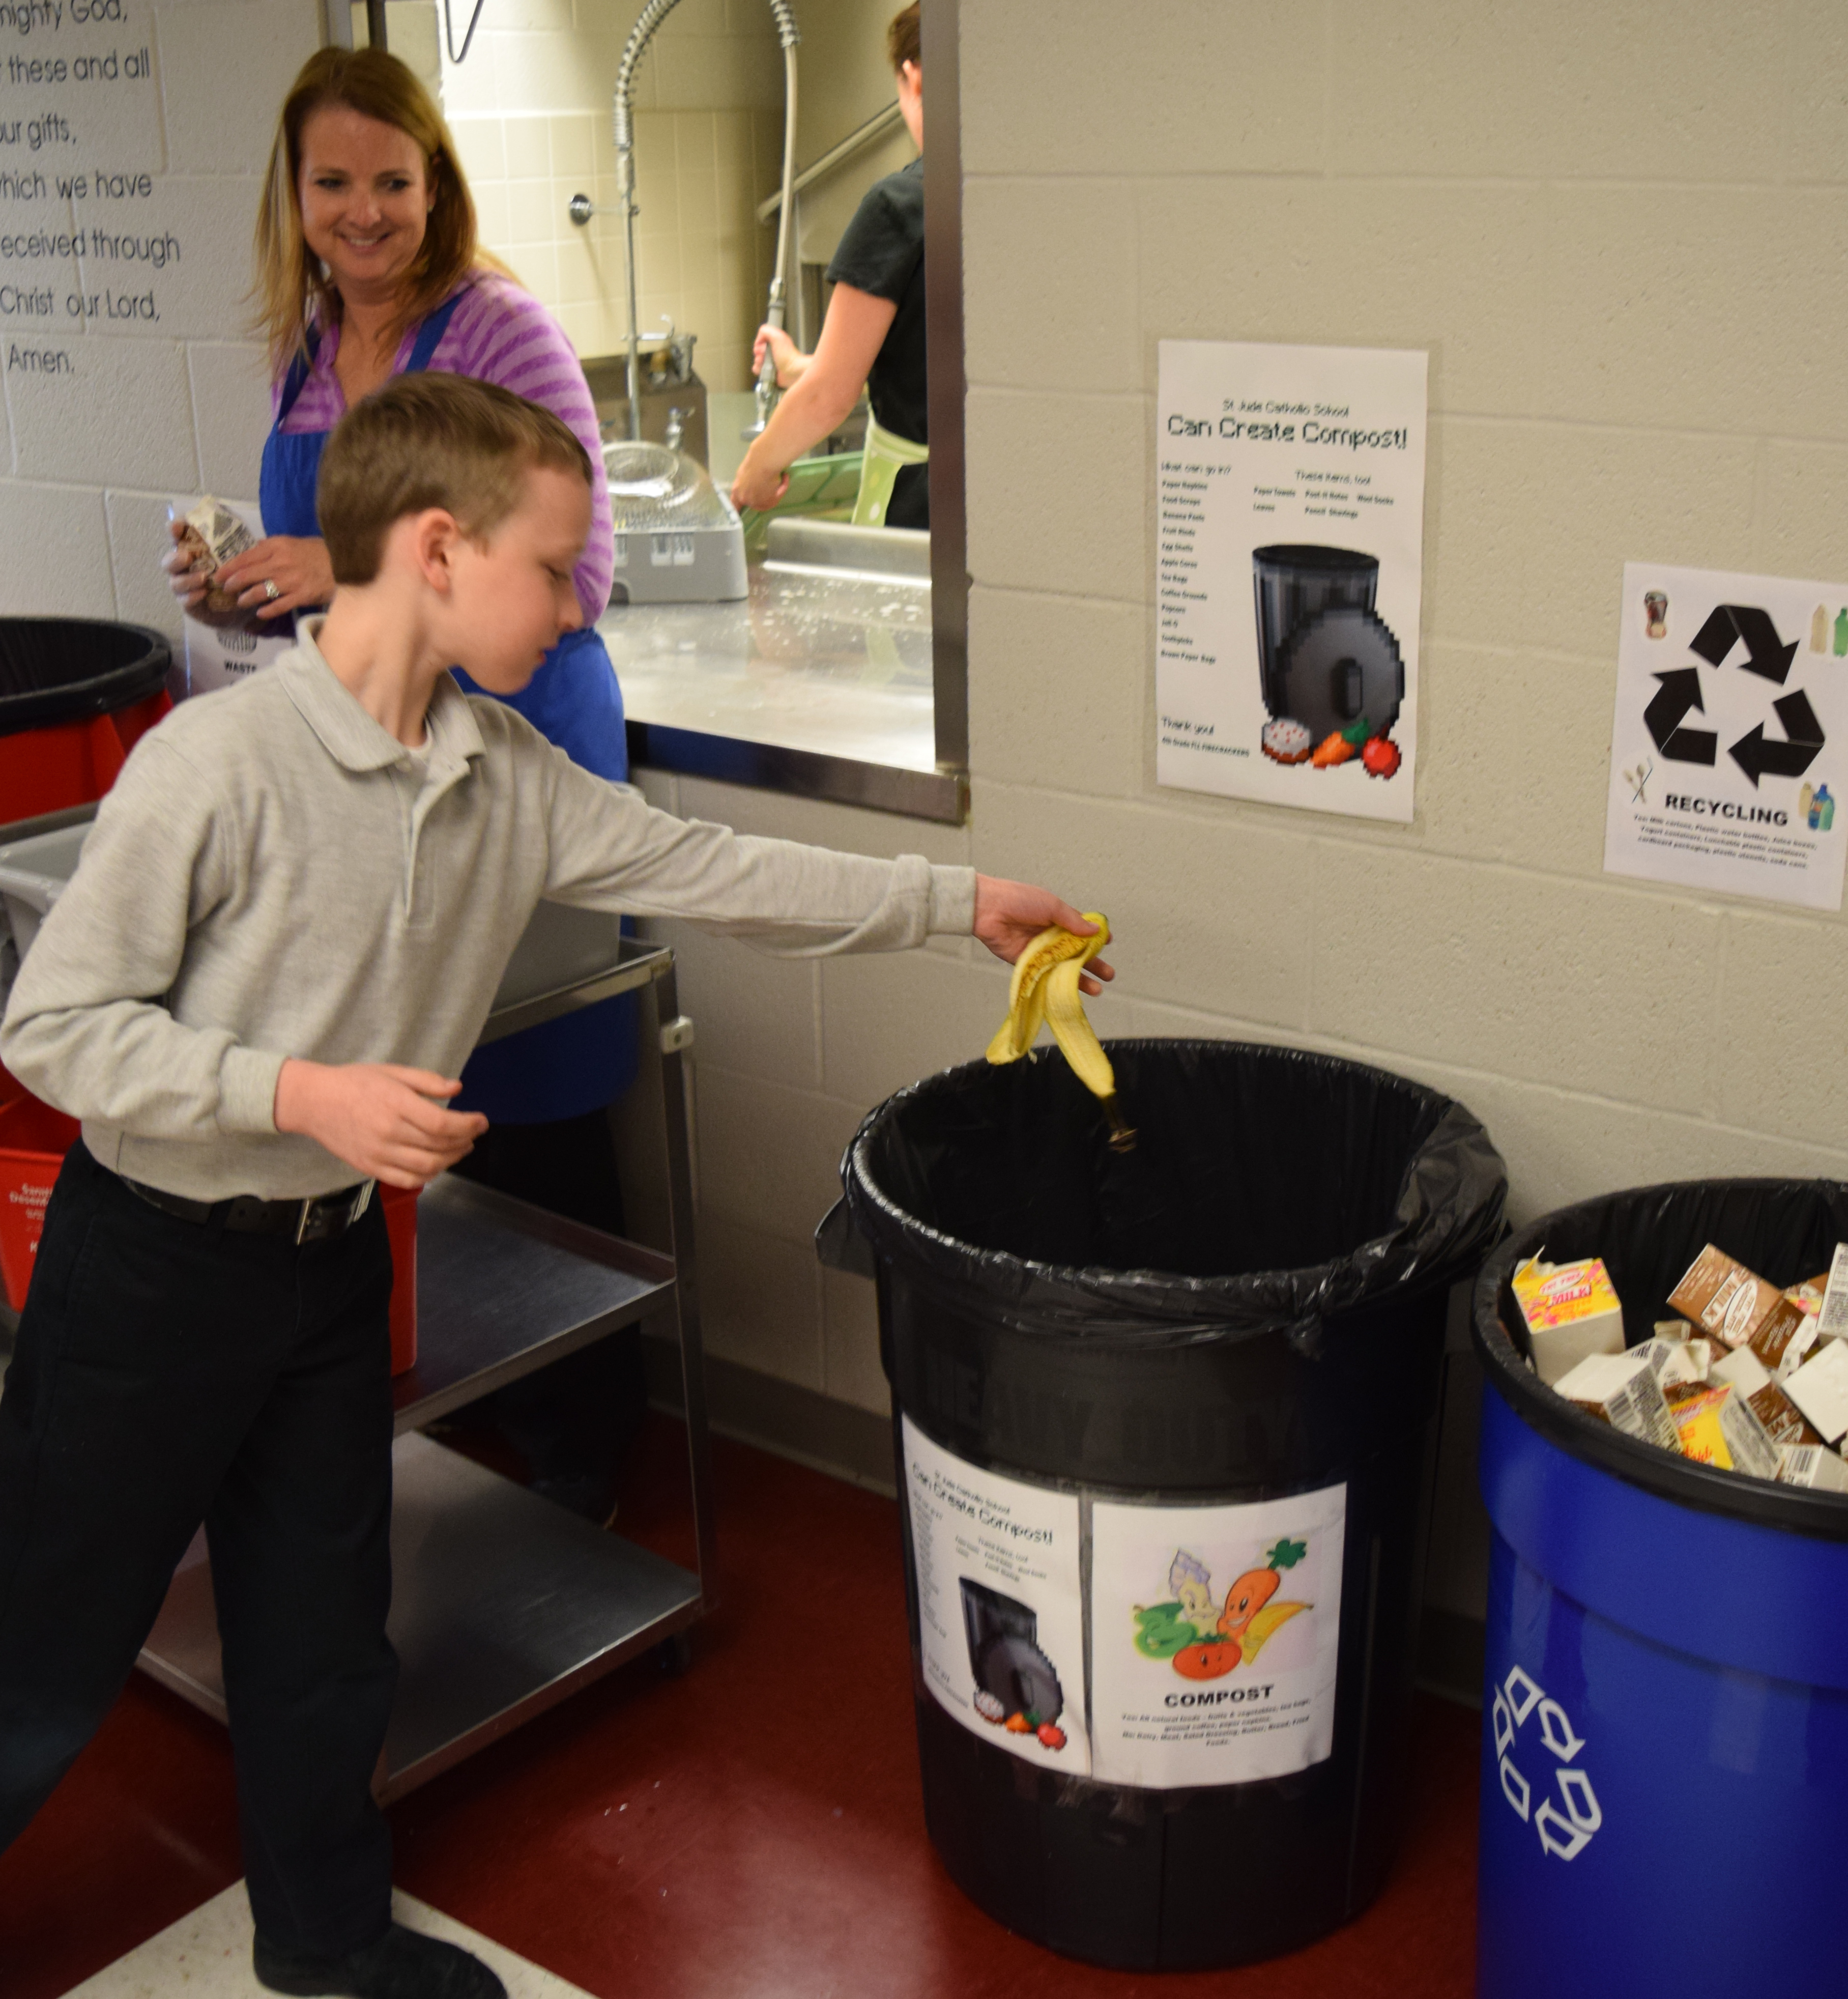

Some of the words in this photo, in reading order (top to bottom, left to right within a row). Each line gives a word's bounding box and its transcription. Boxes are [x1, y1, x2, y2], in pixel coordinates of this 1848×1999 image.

[70, 0, 127, 23] God,
[9, 54, 67, 84] these
[74, 49, 118, 81] and
[124, 47, 149, 79] all
[27, 113, 76, 151] gifts,
[55, 175, 88, 199] we
[95, 169, 152, 200] have
[93, 227, 180, 269] through
[0, 285, 54, 316] Christ
[67, 293, 100, 318] our
[106, 288, 161, 323] Lord,
[1238, 399, 1262, 413] Jude
[1265, 400, 1310, 415] Catholic
[1314, 402, 1349, 418] School
[1168, 414, 1212, 437] Can
[1220, 416, 1295, 442] Create
[1303, 421, 1407, 451] Compost!
[1161, 716, 1191, 732] Thank
[1665, 793, 1788, 827] RECYCLING
[1637, 836, 1672, 846] cardboard
[1712, 847, 1736, 858] plastic
[1641, 825, 1663, 835] Yogurt
[1742, 842, 1766, 852] plastic
[1695, 823, 1719, 835] Plastic
[1721, 830, 1741, 838] water
[1773, 836, 1792, 846] Juice
[1552, 1287, 1589, 1306] MILK
[913, 1462, 932, 1491] Can
[934, 1480, 976, 1519] Create
[979, 1507, 1053, 1547] Compost!
[1164, 1683, 1275, 1708] COMPOST
